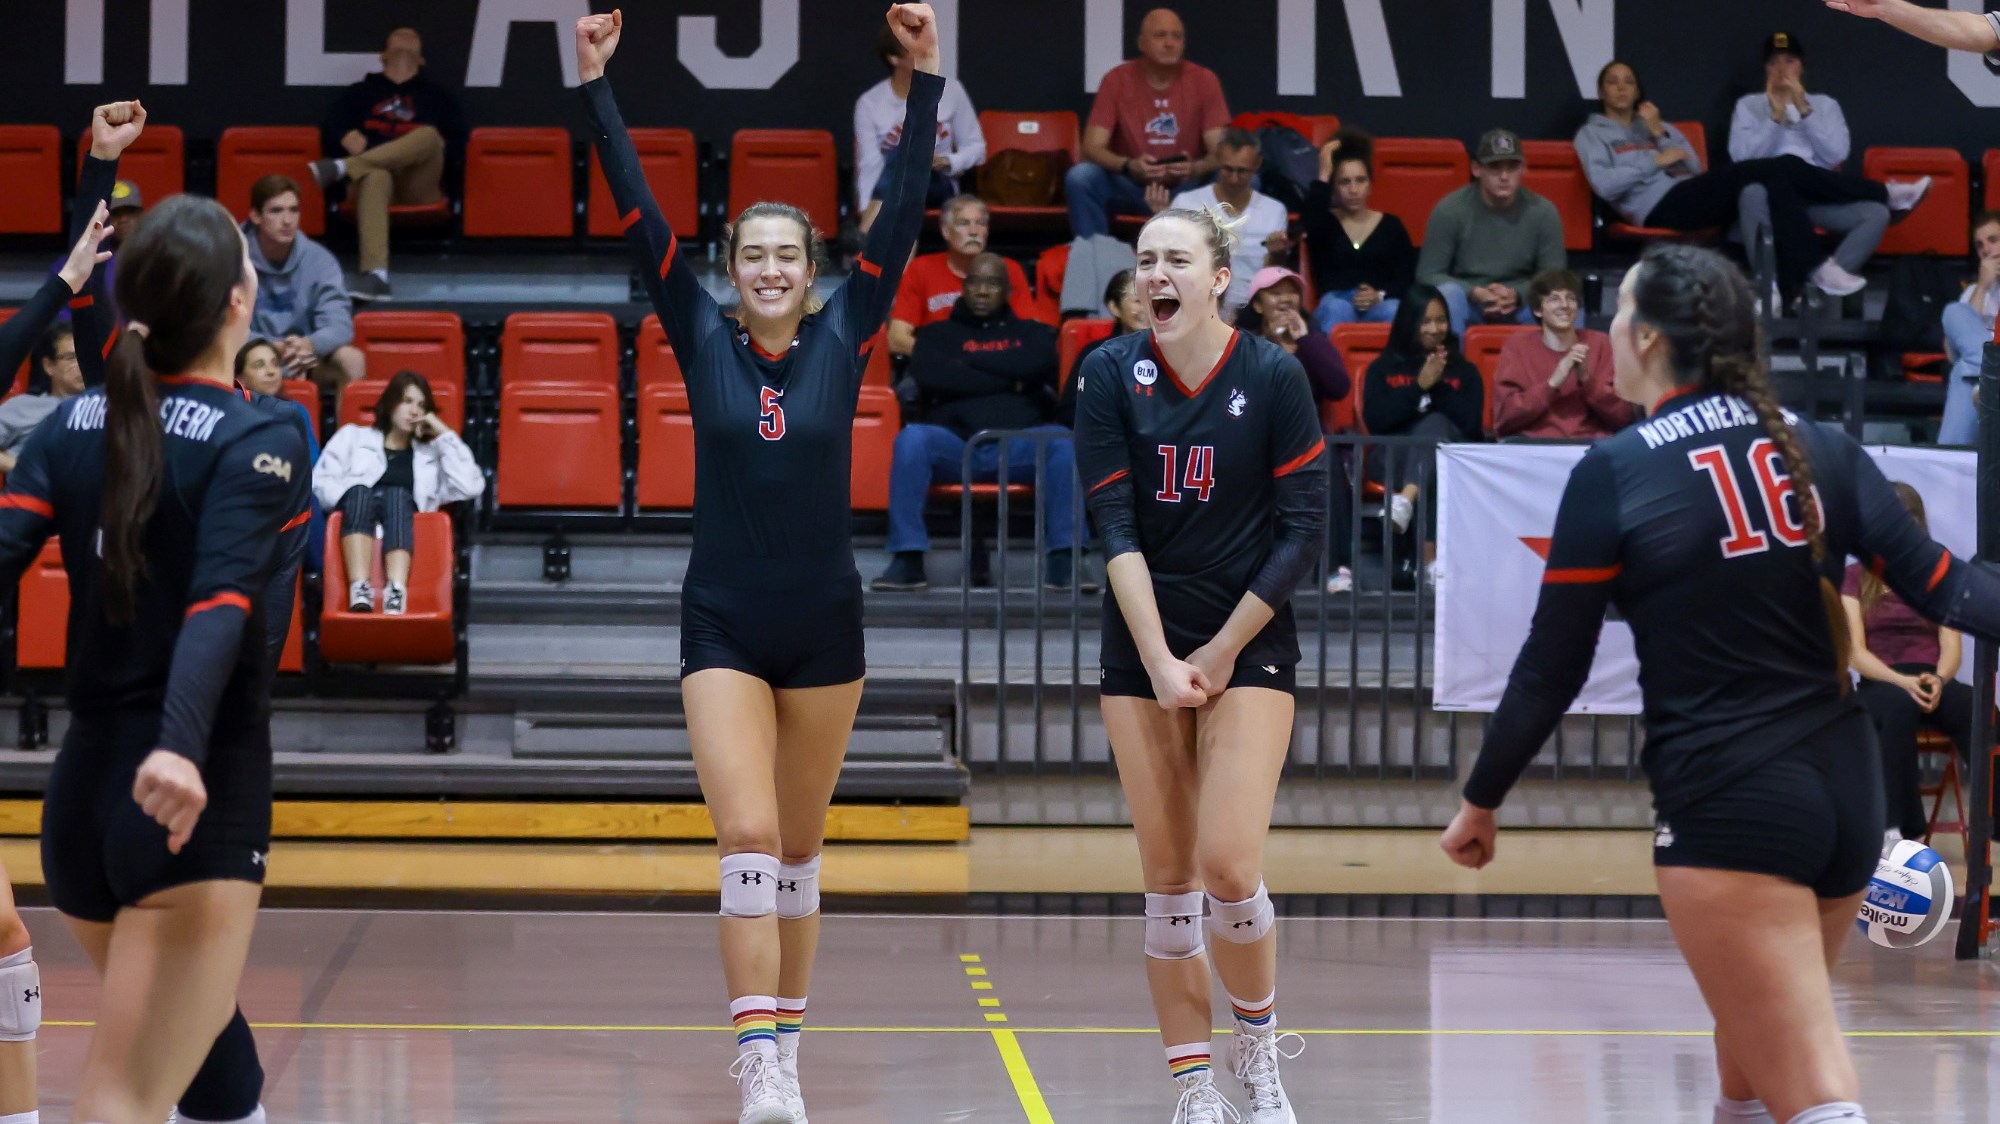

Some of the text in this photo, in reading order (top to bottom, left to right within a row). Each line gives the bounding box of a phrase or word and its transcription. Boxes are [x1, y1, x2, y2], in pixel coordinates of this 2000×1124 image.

[1137, 366, 1155, 378] BLM
[66, 395, 225, 442] NORSTERN
[758, 385, 786, 441] 5
[1156, 444, 1216, 503] 14
[1687, 437, 1826, 559] 16
[1860, 903, 1909, 927] molte
[1868, 885, 1909, 909] NCA
